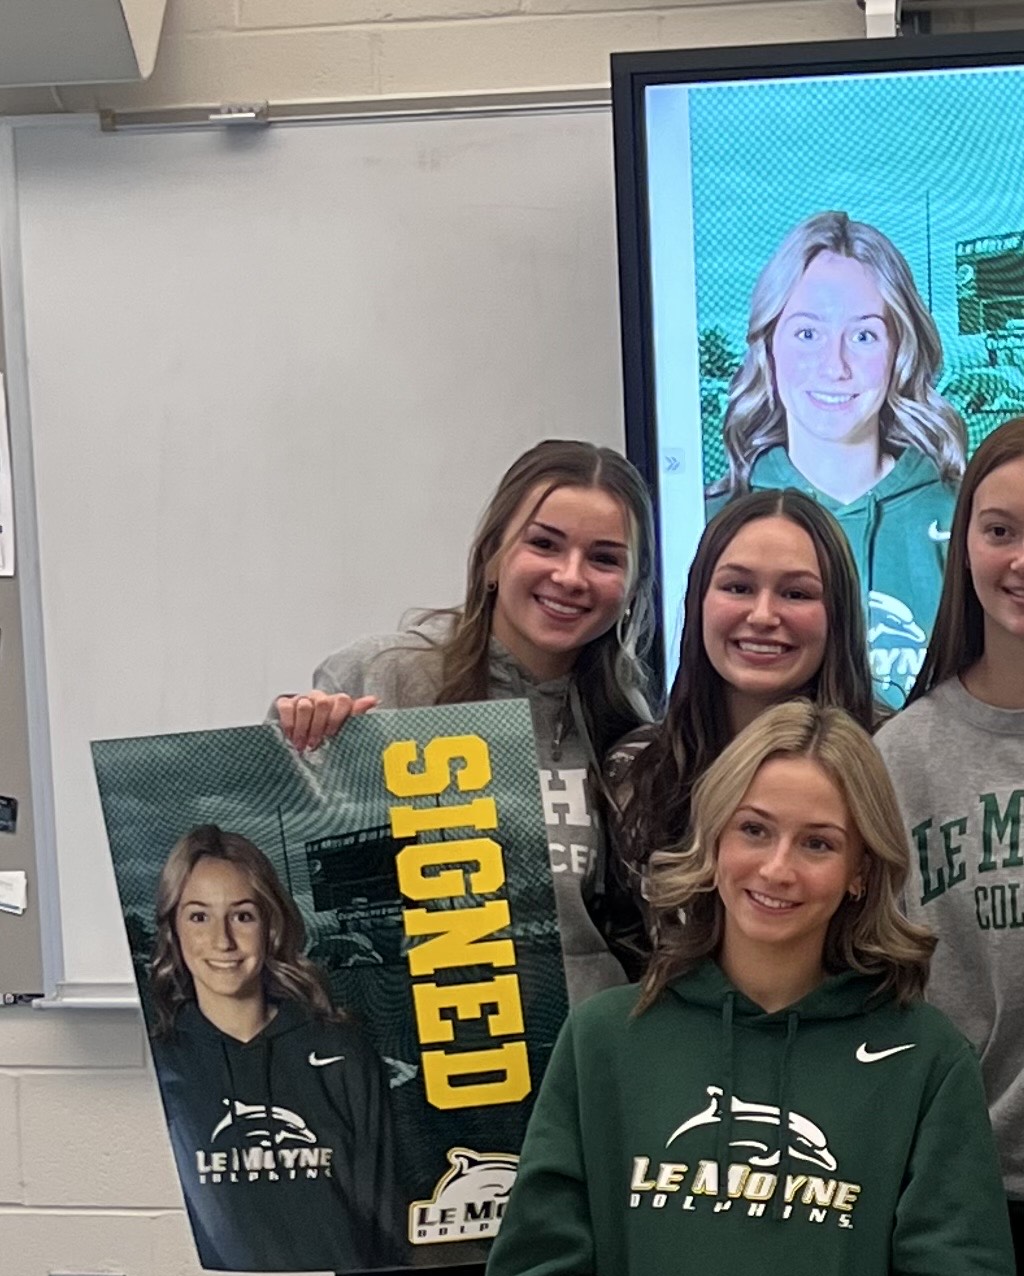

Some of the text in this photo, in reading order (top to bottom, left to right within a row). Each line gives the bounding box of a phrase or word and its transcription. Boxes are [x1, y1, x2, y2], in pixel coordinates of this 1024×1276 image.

[912, 818, 967, 906] LE
[383, 734, 532, 1110] SIGNED
[196, 1150, 228, 1173] LE
[630, 1156, 689, 1192] LE
[417, 1207, 457, 1227] LE
